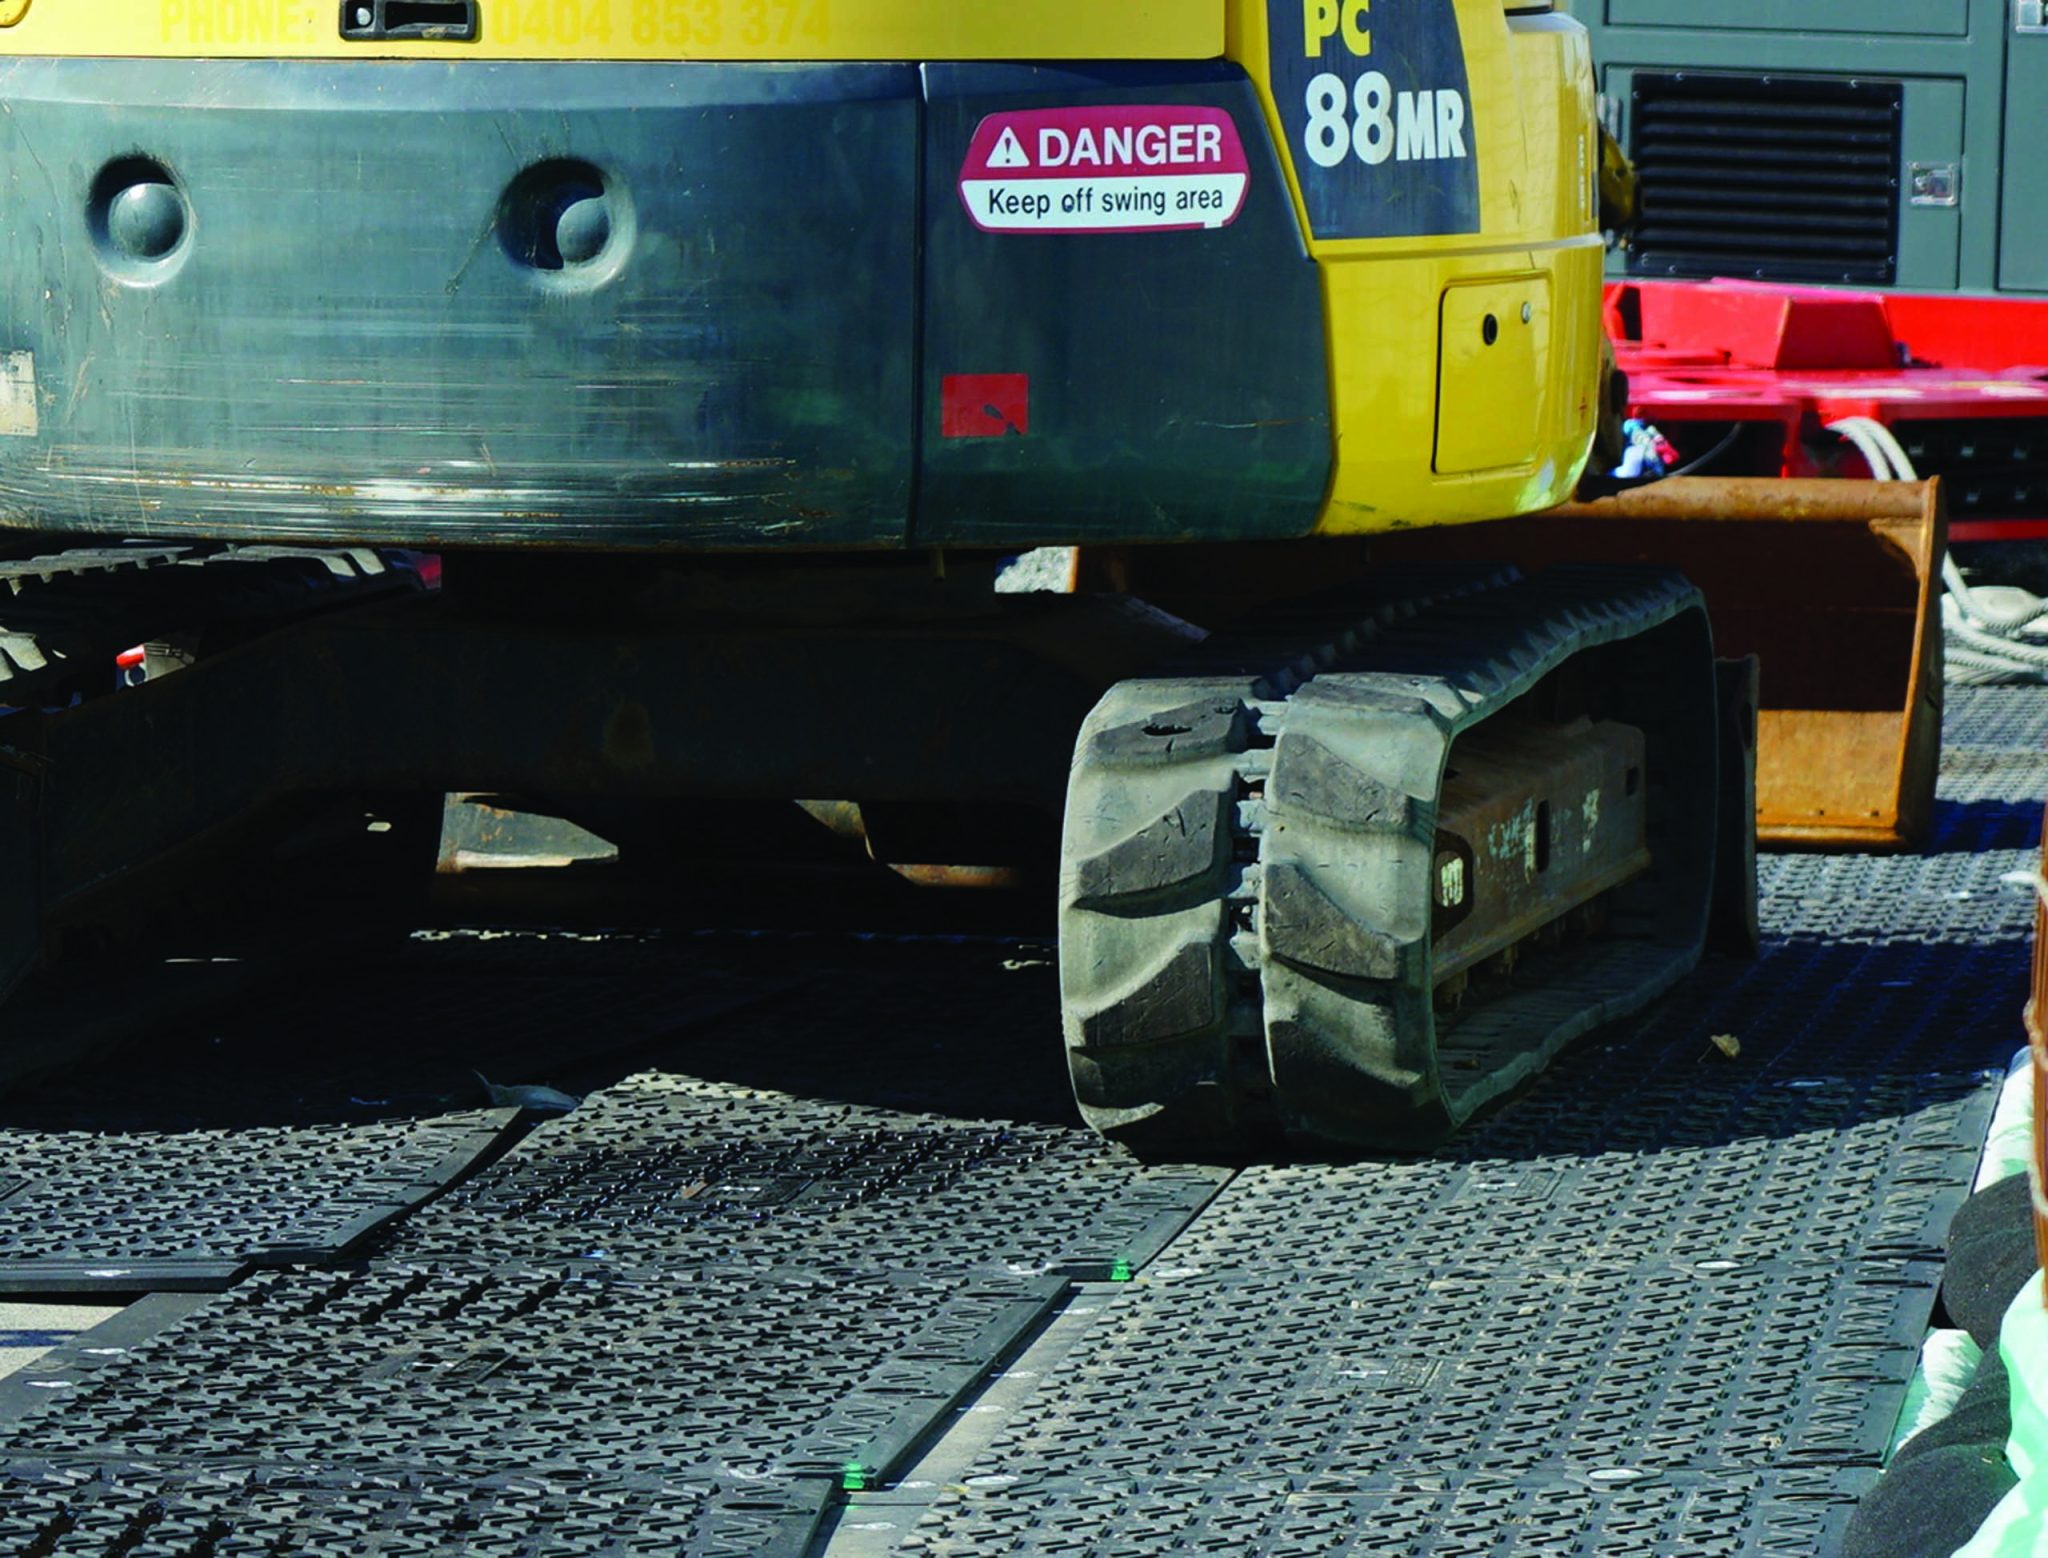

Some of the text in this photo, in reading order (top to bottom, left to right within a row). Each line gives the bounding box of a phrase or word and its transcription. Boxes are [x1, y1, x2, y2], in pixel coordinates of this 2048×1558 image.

[491, 0, 612, 45] 0404
[630, 0, 722, 45] 853
[740, 0, 829, 44] 374
[1303, 0, 1371, 58] PC
[1038, 124, 1222, 168] DANGER
[988, 185, 1224, 219] Keep off swing area
